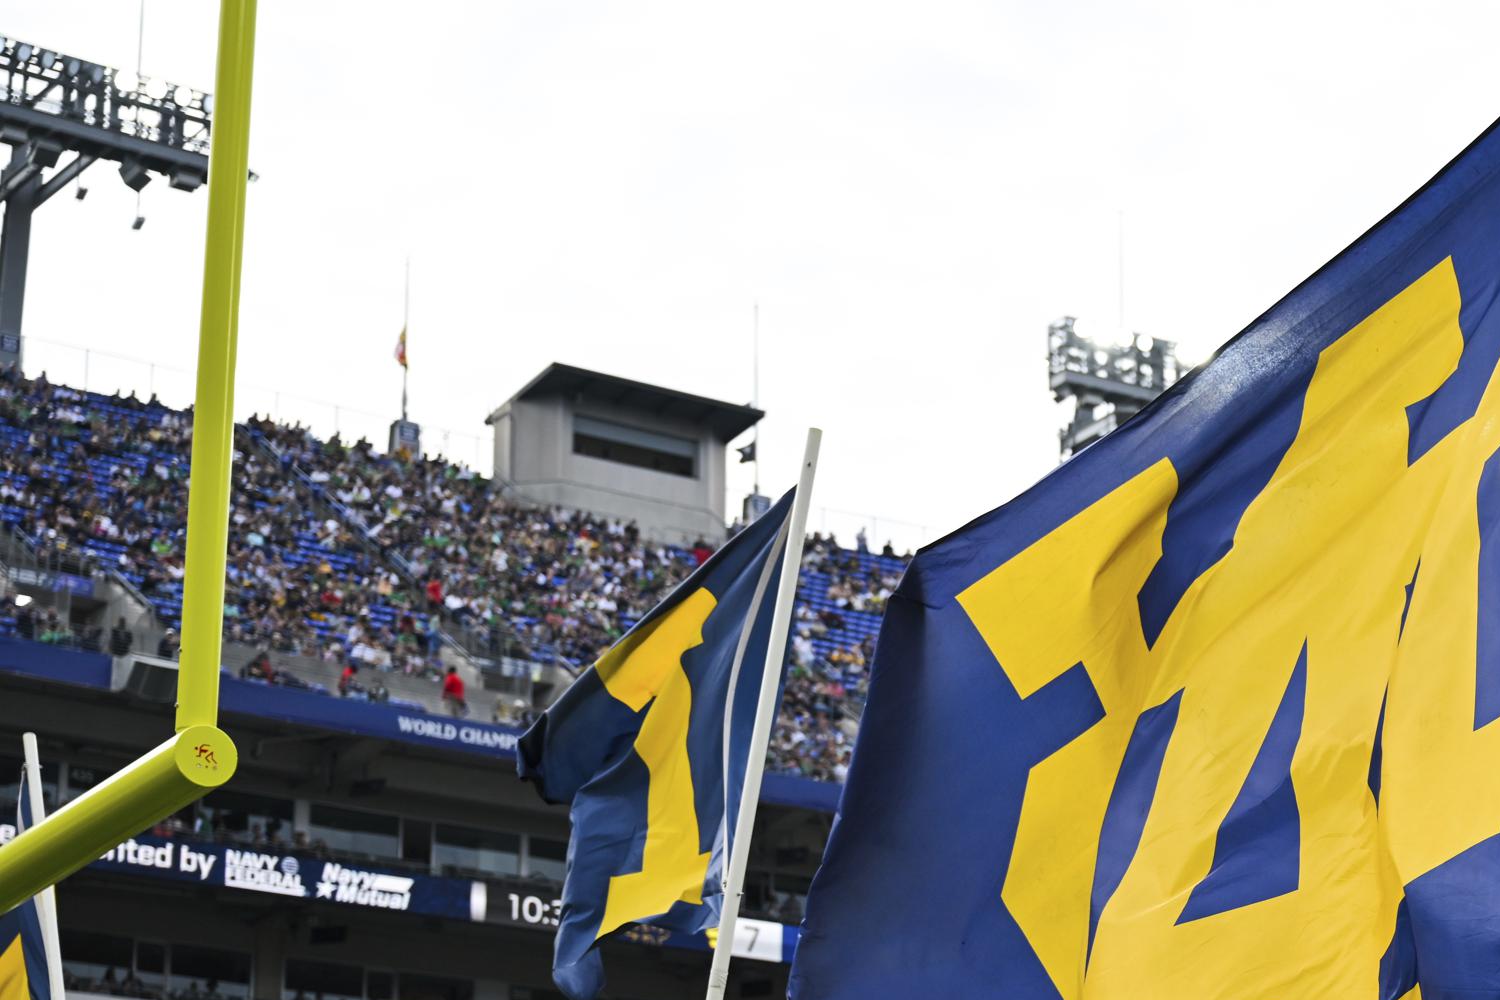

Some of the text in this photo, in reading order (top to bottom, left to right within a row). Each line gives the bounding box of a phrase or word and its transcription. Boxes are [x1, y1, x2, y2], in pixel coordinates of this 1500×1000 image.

[398, 715, 457, 741] WORLD
[179, 844, 217, 880] by
[225, 848, 279, 871] NAVY
[225, 866, 304, 890] FEDERAL
[321, 862, 377, 888] Navy
[335, 884, 412, 911] Mutual
[745, 925, 760, 952] 7
